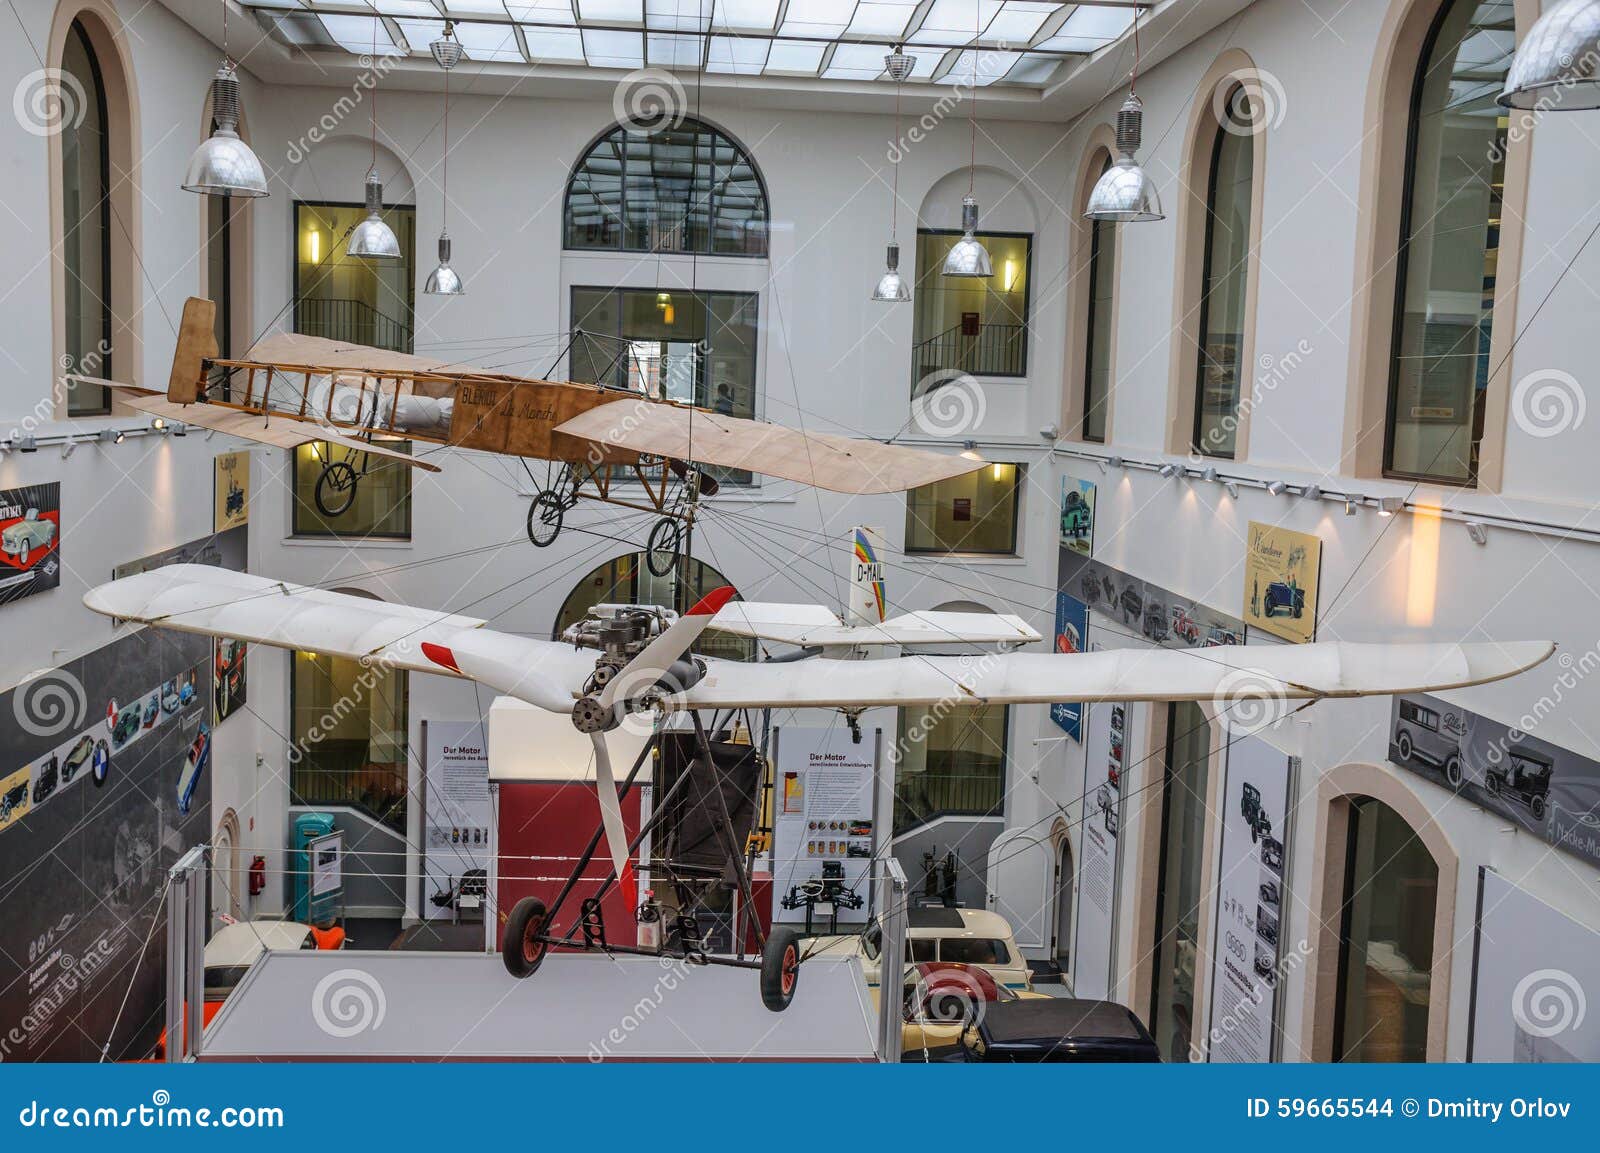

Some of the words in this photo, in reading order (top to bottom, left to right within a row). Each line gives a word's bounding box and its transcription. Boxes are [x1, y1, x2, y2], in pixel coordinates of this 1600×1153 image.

[458, 746, 481, 754] Motor
[809, 753, 822, 761] Der
[824, 753, 846, 761] Motor
